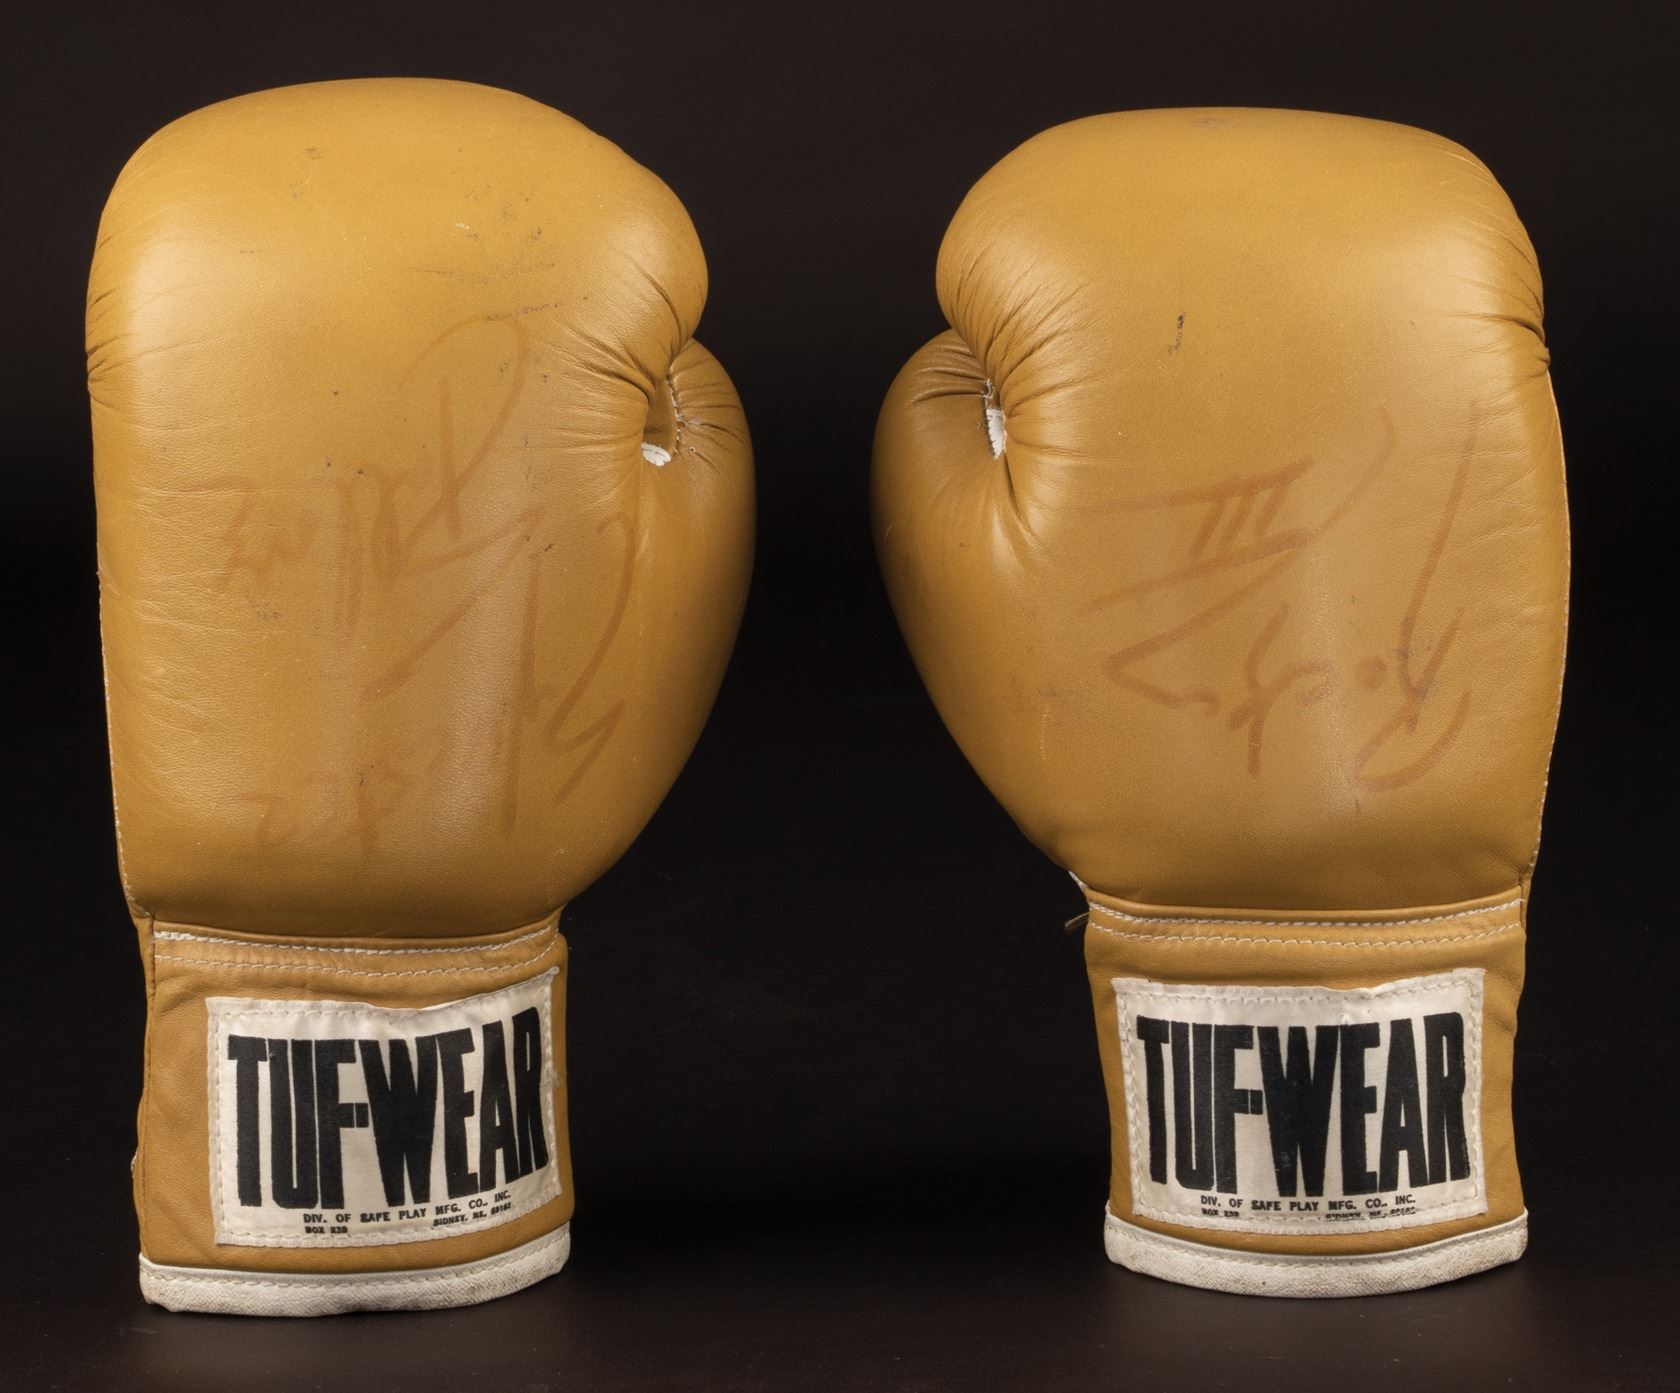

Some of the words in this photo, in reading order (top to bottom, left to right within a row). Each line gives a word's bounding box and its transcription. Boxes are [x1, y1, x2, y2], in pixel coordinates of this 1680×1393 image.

[303, 1213, 327, 1223] DIV.
[335, 1213, 352, 1223] OF
[360, 1212, 391, 1223] SAFE
[398, 1208, 427, 1220] PLAY
[435, 1203, 461, 1215] MFG.
[494, 1190, 511, 1203] INC.
[1200, 1195, 1221, 1207] DIV.
[1228, 1198, 1243, 1208] OF
[1251, 1200, 1281, 1211] SAFE
[1289, 1201, 1319, 1211] PLAY
[1328, 1200, 1356, 1210] MFG.
[1395, 1194, 1416, 1205] INC.
[304, 1226, 325, 1234] BOX
